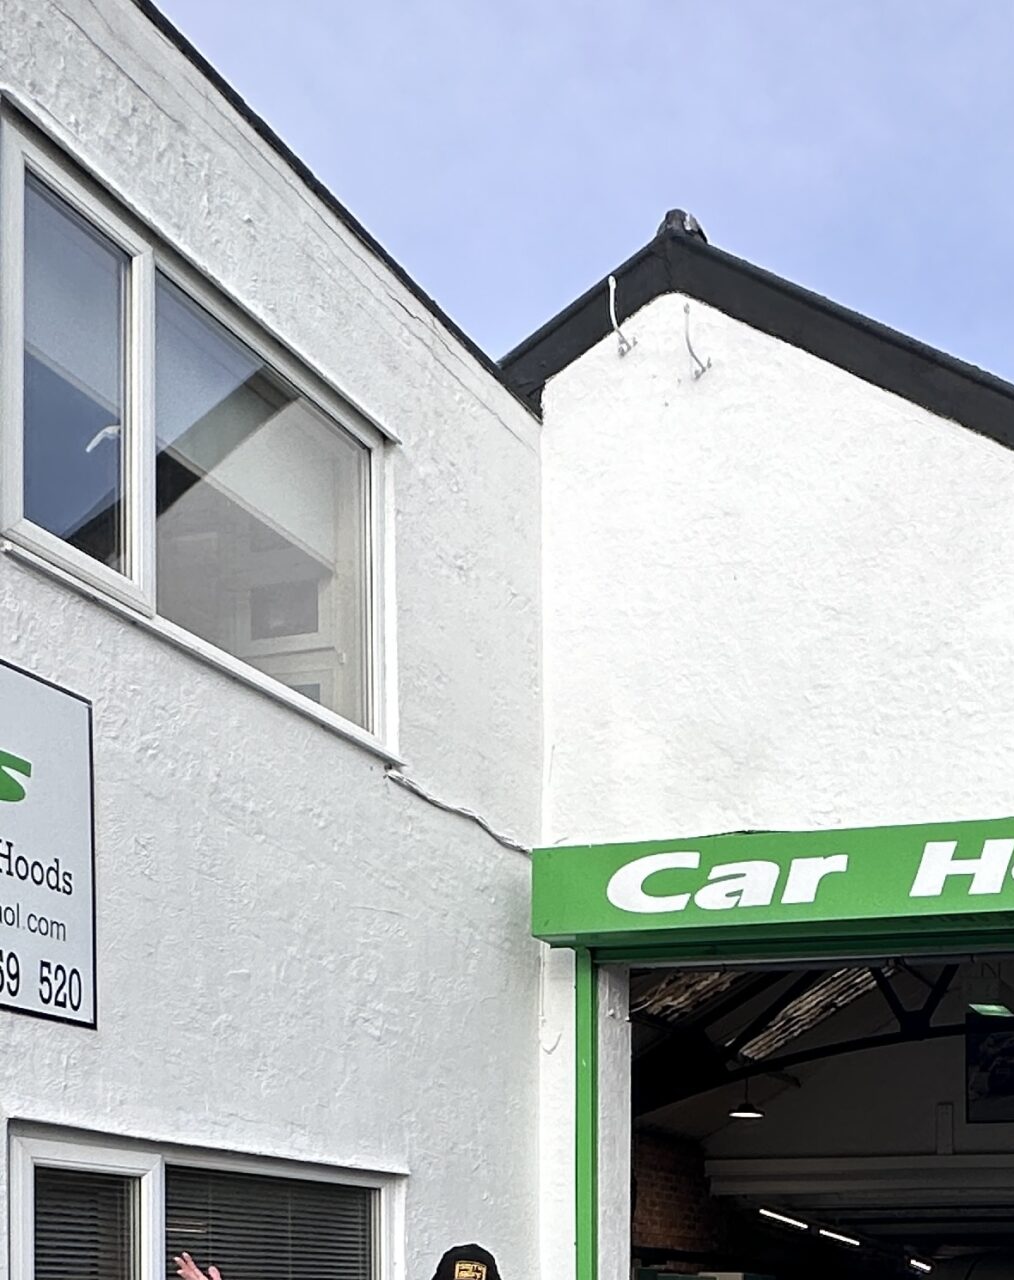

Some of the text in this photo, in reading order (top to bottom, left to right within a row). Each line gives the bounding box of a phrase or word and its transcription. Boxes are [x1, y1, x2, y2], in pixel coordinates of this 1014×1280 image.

[0, 838, 73, 896] Hoods
[605, 850, 849, 914] Car
[0, 902, 67, 942] ol.com
[38, 959, 82, 1012] 520
